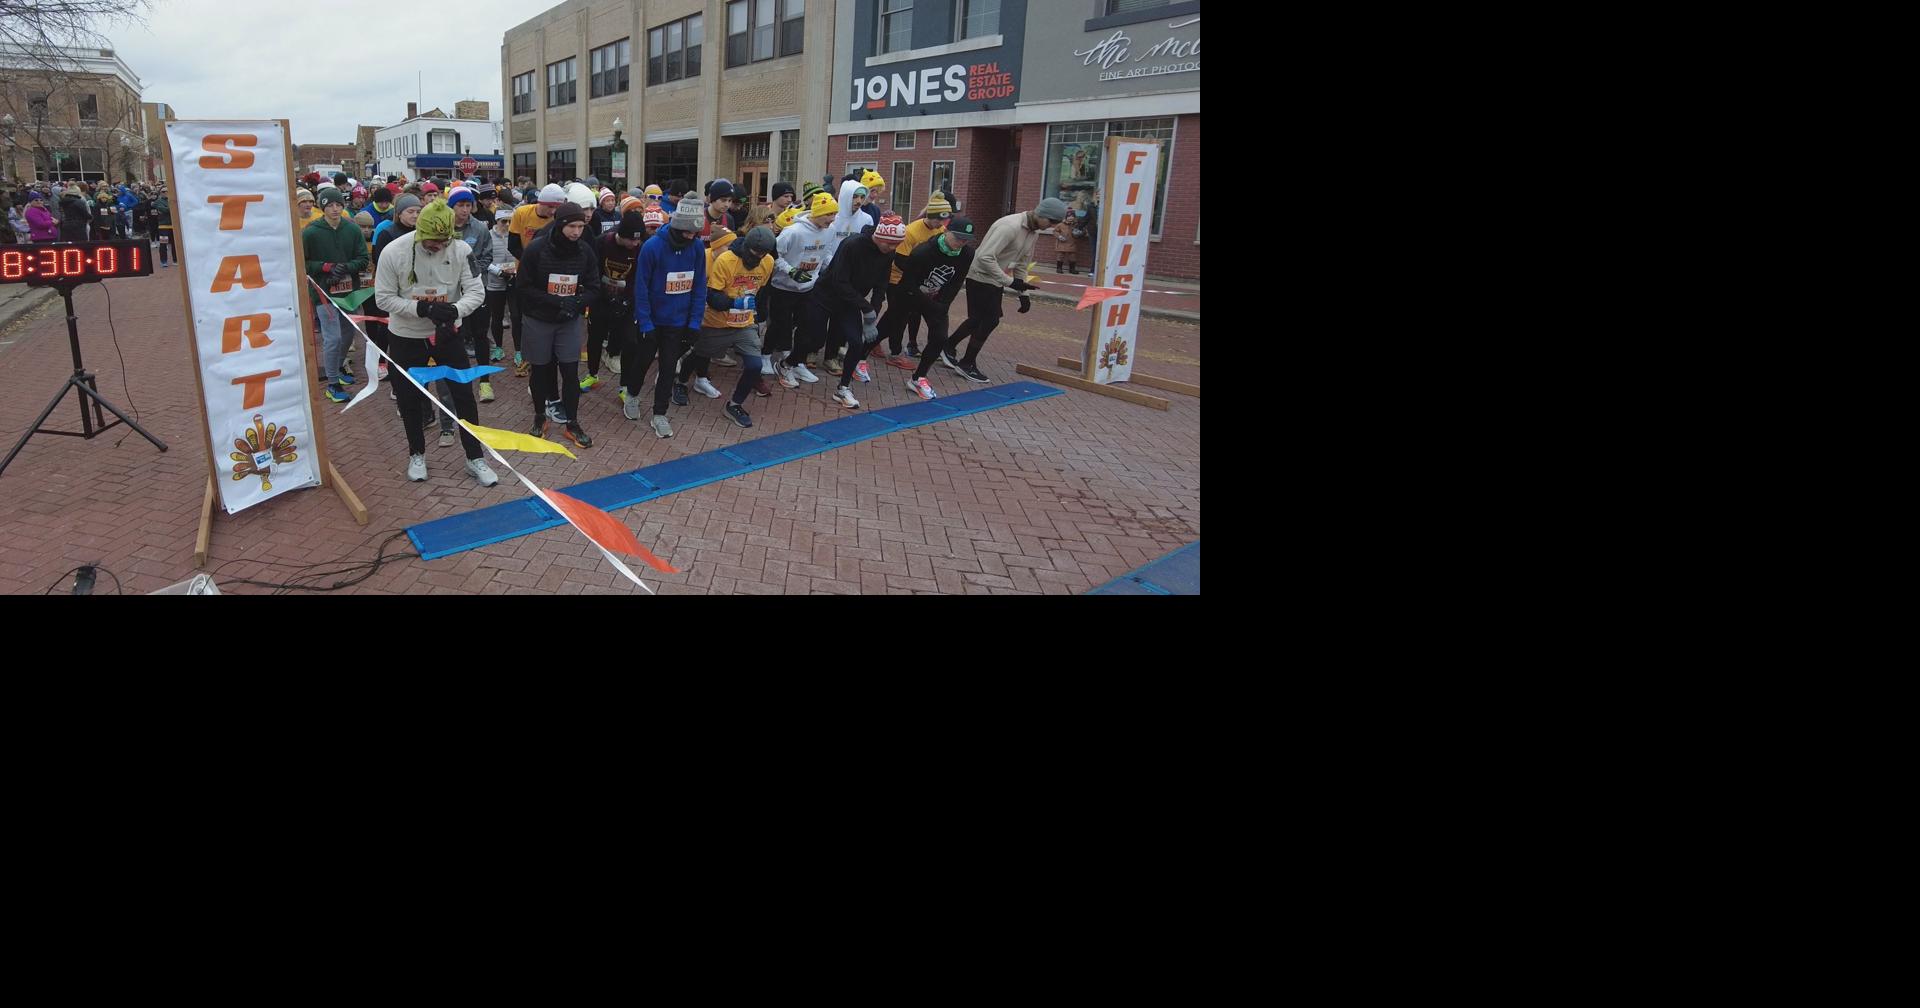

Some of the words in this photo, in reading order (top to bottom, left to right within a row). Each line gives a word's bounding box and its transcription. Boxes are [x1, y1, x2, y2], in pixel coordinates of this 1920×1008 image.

[1073, 30, 1131, 69] the
[970, 62, 1000, 75] REAL
[1100, 71, 1124, 79] FINE
[1127, 67, 1149, 77] ART
[851, 64, 967, 110] JONES
[969, 72, 1011, 88] ESTATE
[968, 85, 1015, 100] GROUP
[460, 162, 476, 170] STOP
[1106, 151, 1148, 328] FINISH
[199, 134, 282, 410] START
[554, 283, 574, 295] 965
[669, 280, 692, 292] 1952
